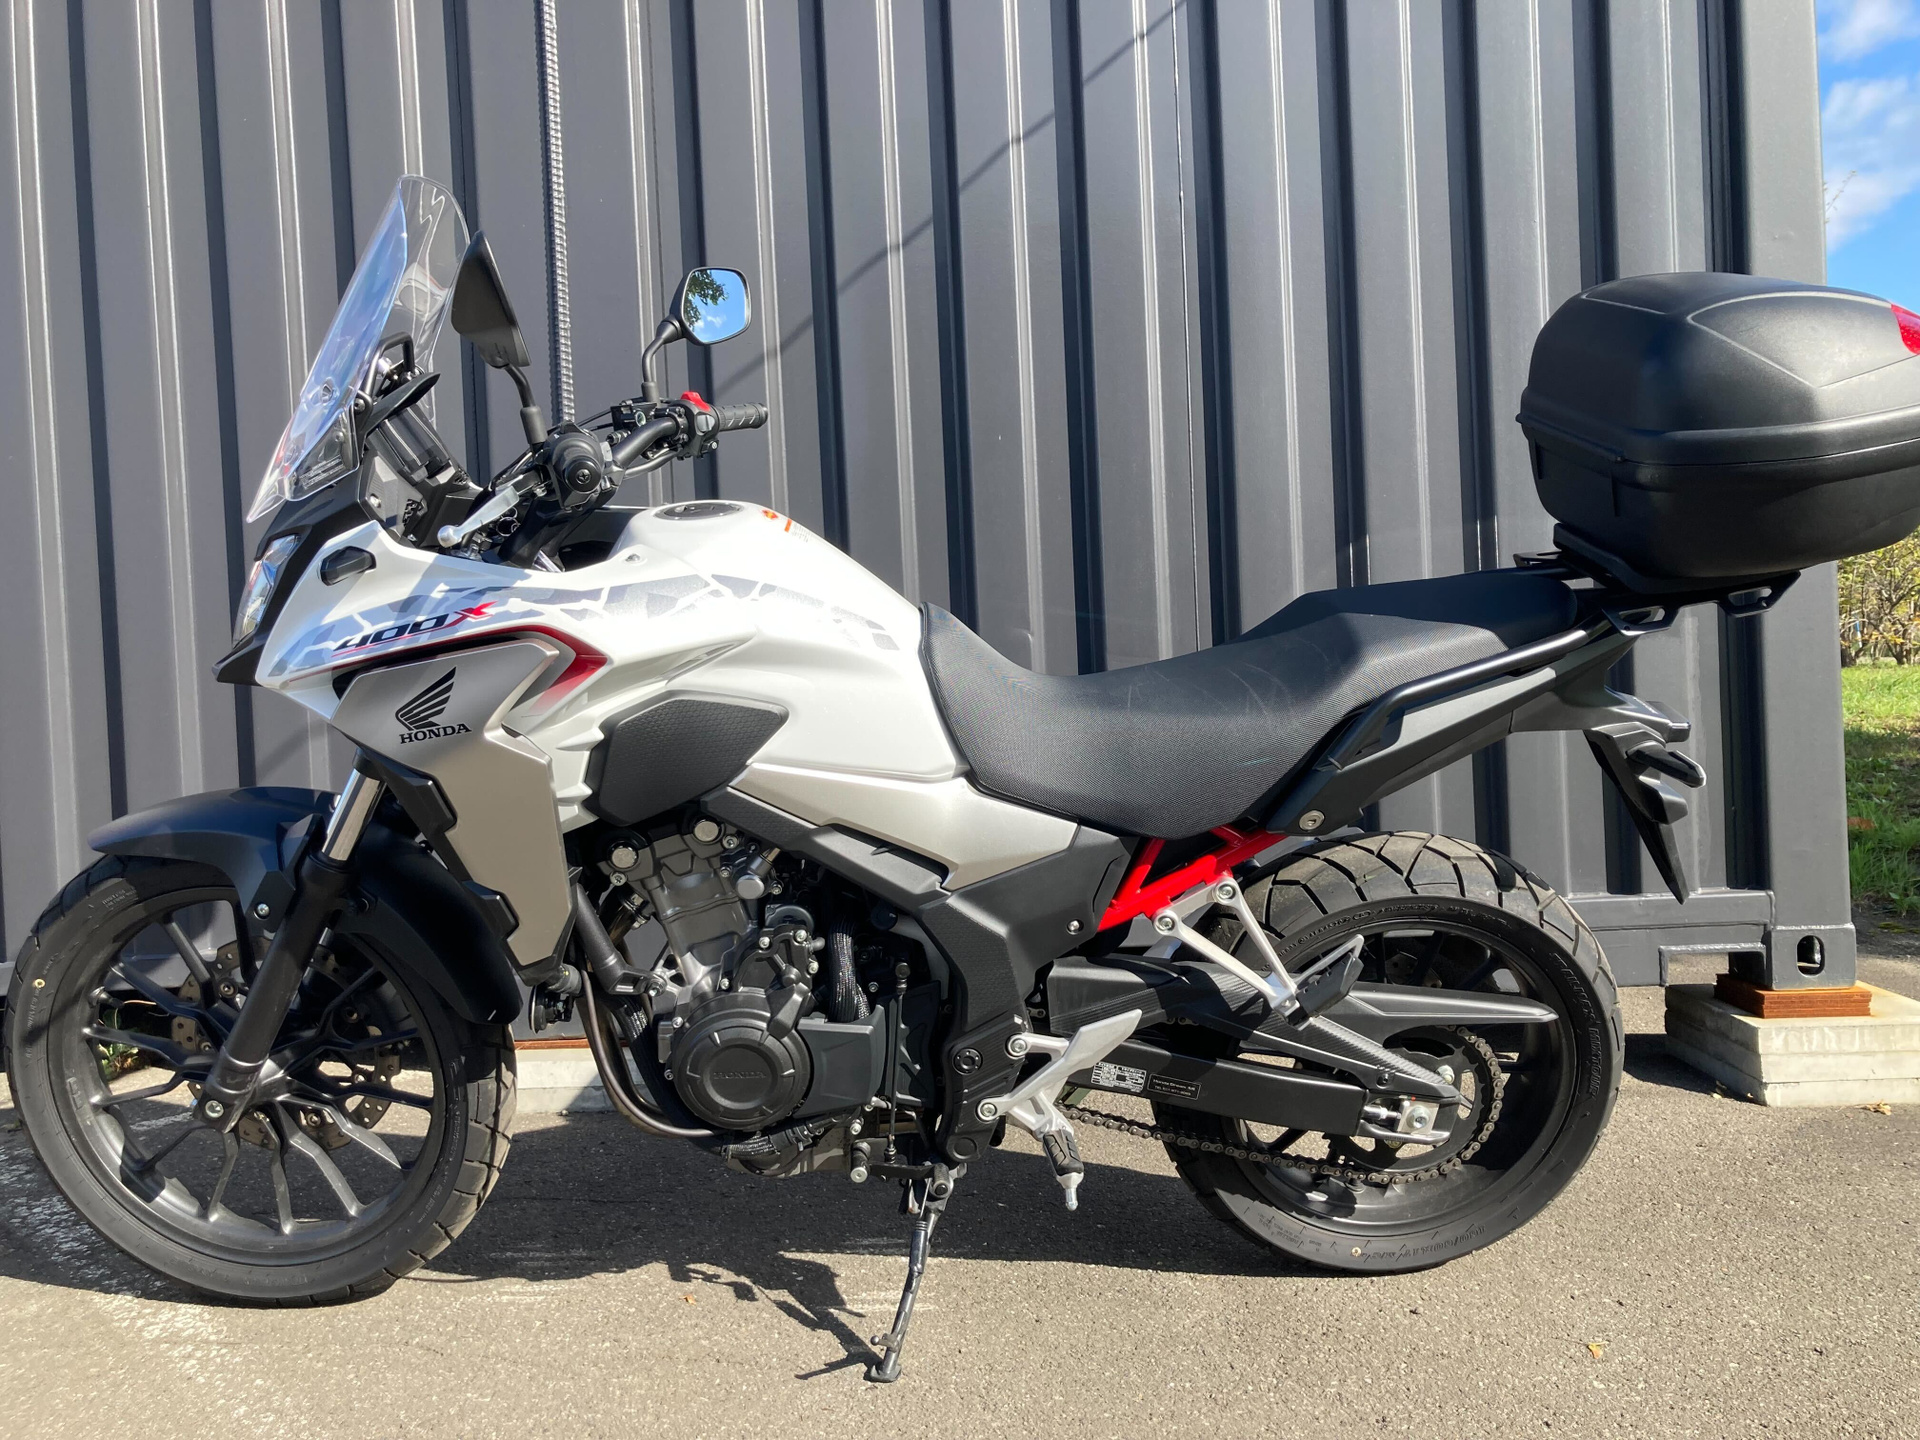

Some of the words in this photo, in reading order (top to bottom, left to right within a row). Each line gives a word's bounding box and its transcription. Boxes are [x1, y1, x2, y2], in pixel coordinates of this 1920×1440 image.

[333, 601, 496, 654] 400X
[399, 723, 472, 744] HONDA
[713, 1072, 766, 1080] HONDA
